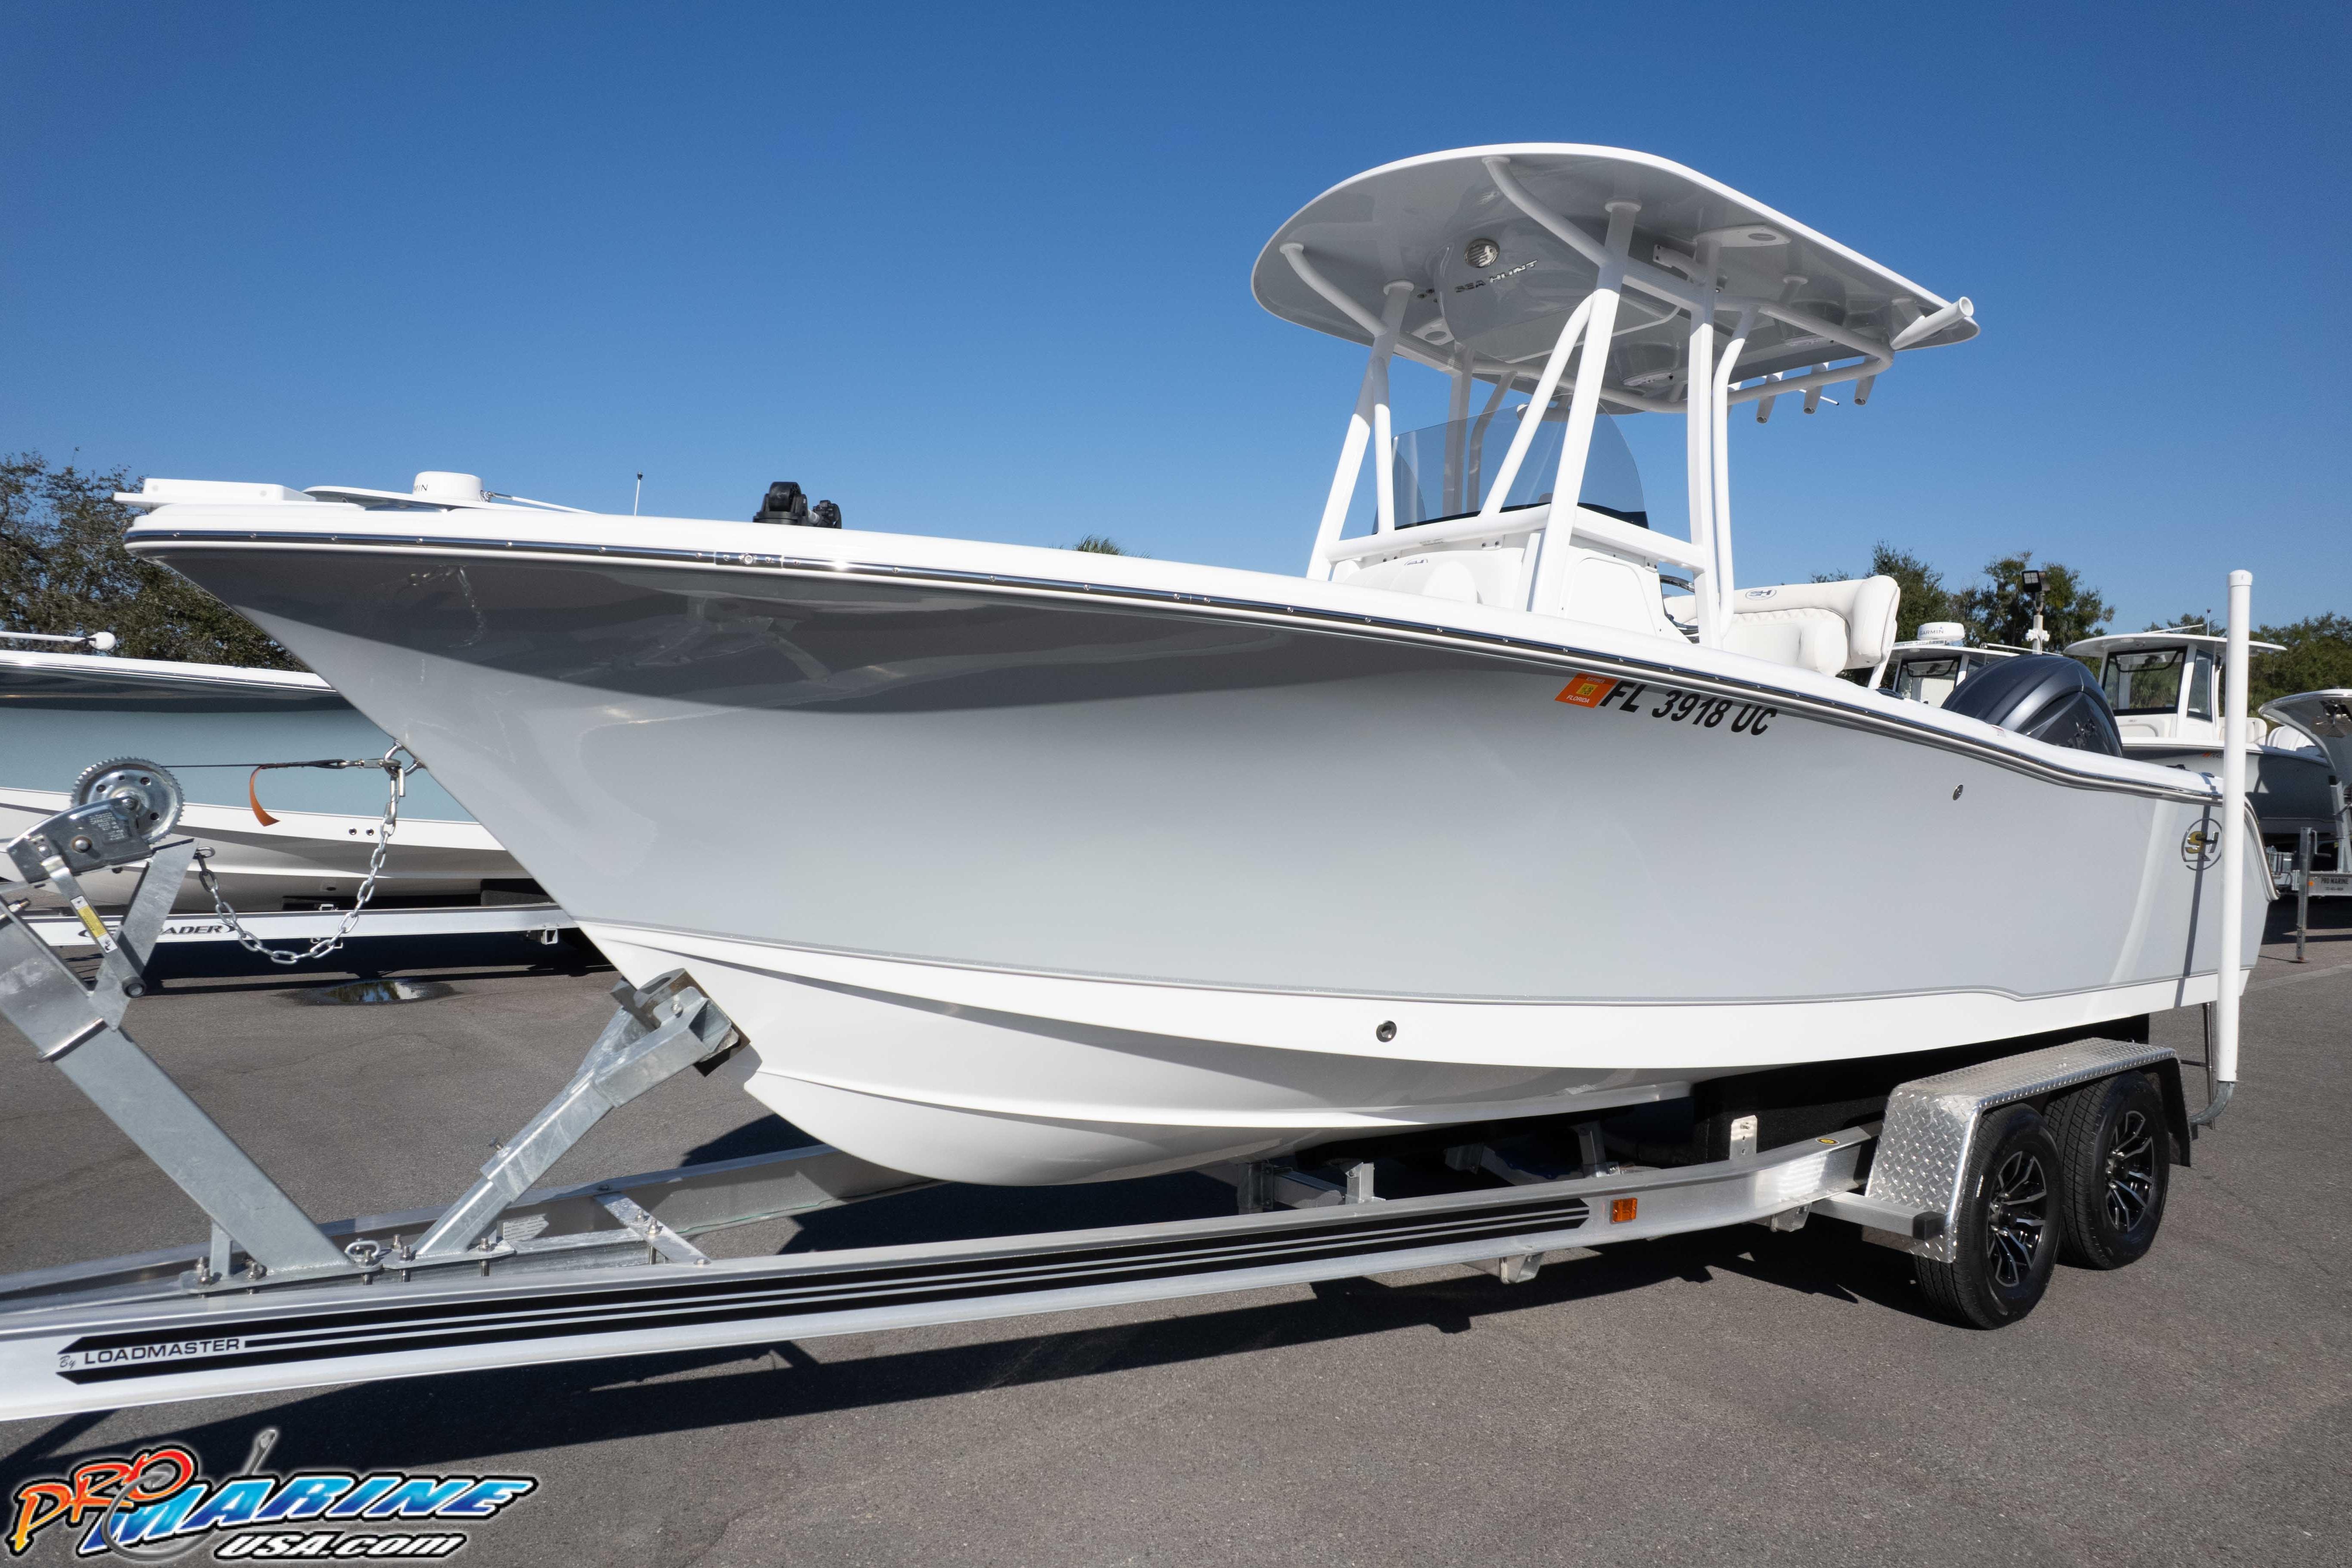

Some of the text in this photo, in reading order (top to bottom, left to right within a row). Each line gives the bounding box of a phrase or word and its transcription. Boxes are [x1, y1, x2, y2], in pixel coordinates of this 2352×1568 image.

[1454, 259, 1538, 293] SEA HUNT
[1566, 695, 1590, 703] FLORIDA
[1599, 681, 1777, 735] FL 3918 UC
[59, 1338, 240, 1369] By LOADMASTER
